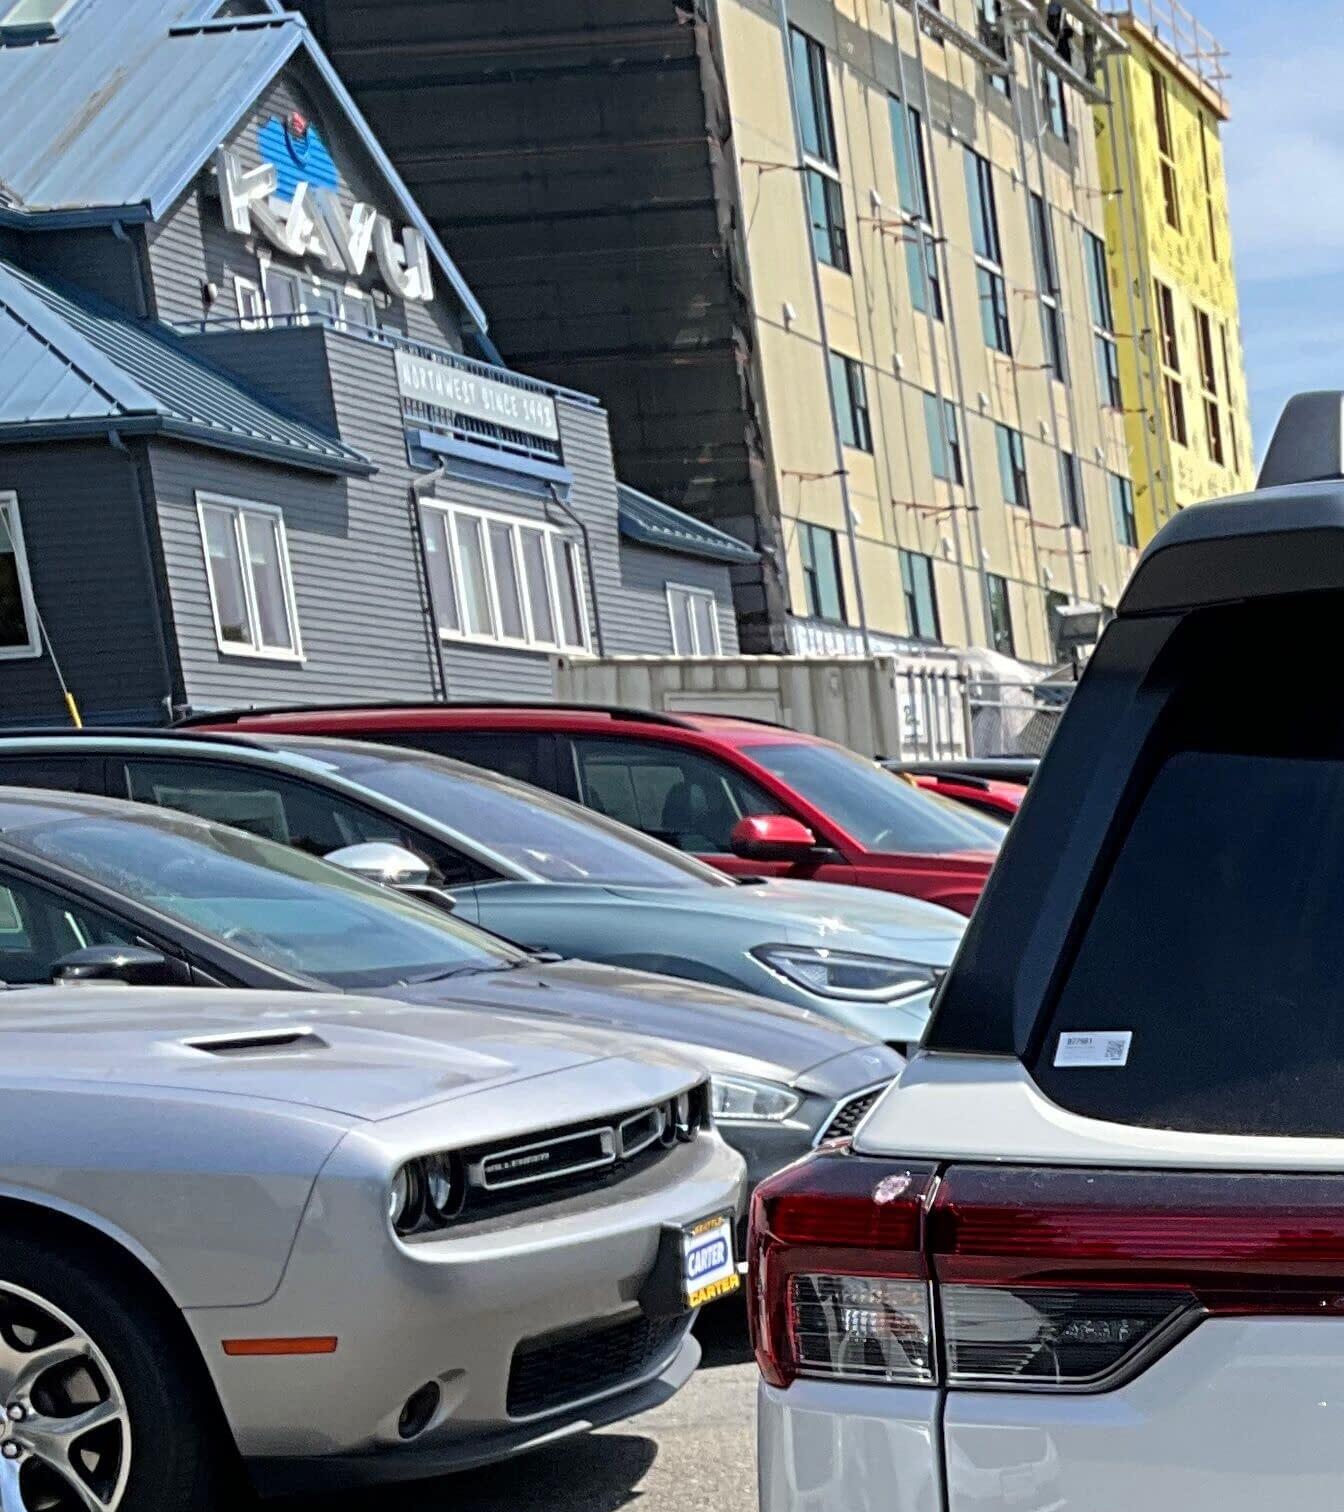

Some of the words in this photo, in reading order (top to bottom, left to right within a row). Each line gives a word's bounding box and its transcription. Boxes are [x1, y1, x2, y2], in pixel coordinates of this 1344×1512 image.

[216, 148, 434, 301] KAVU
[688, 1241, 725, 1276] CARTER
[690, 1273, 740, 1307] CARTER
